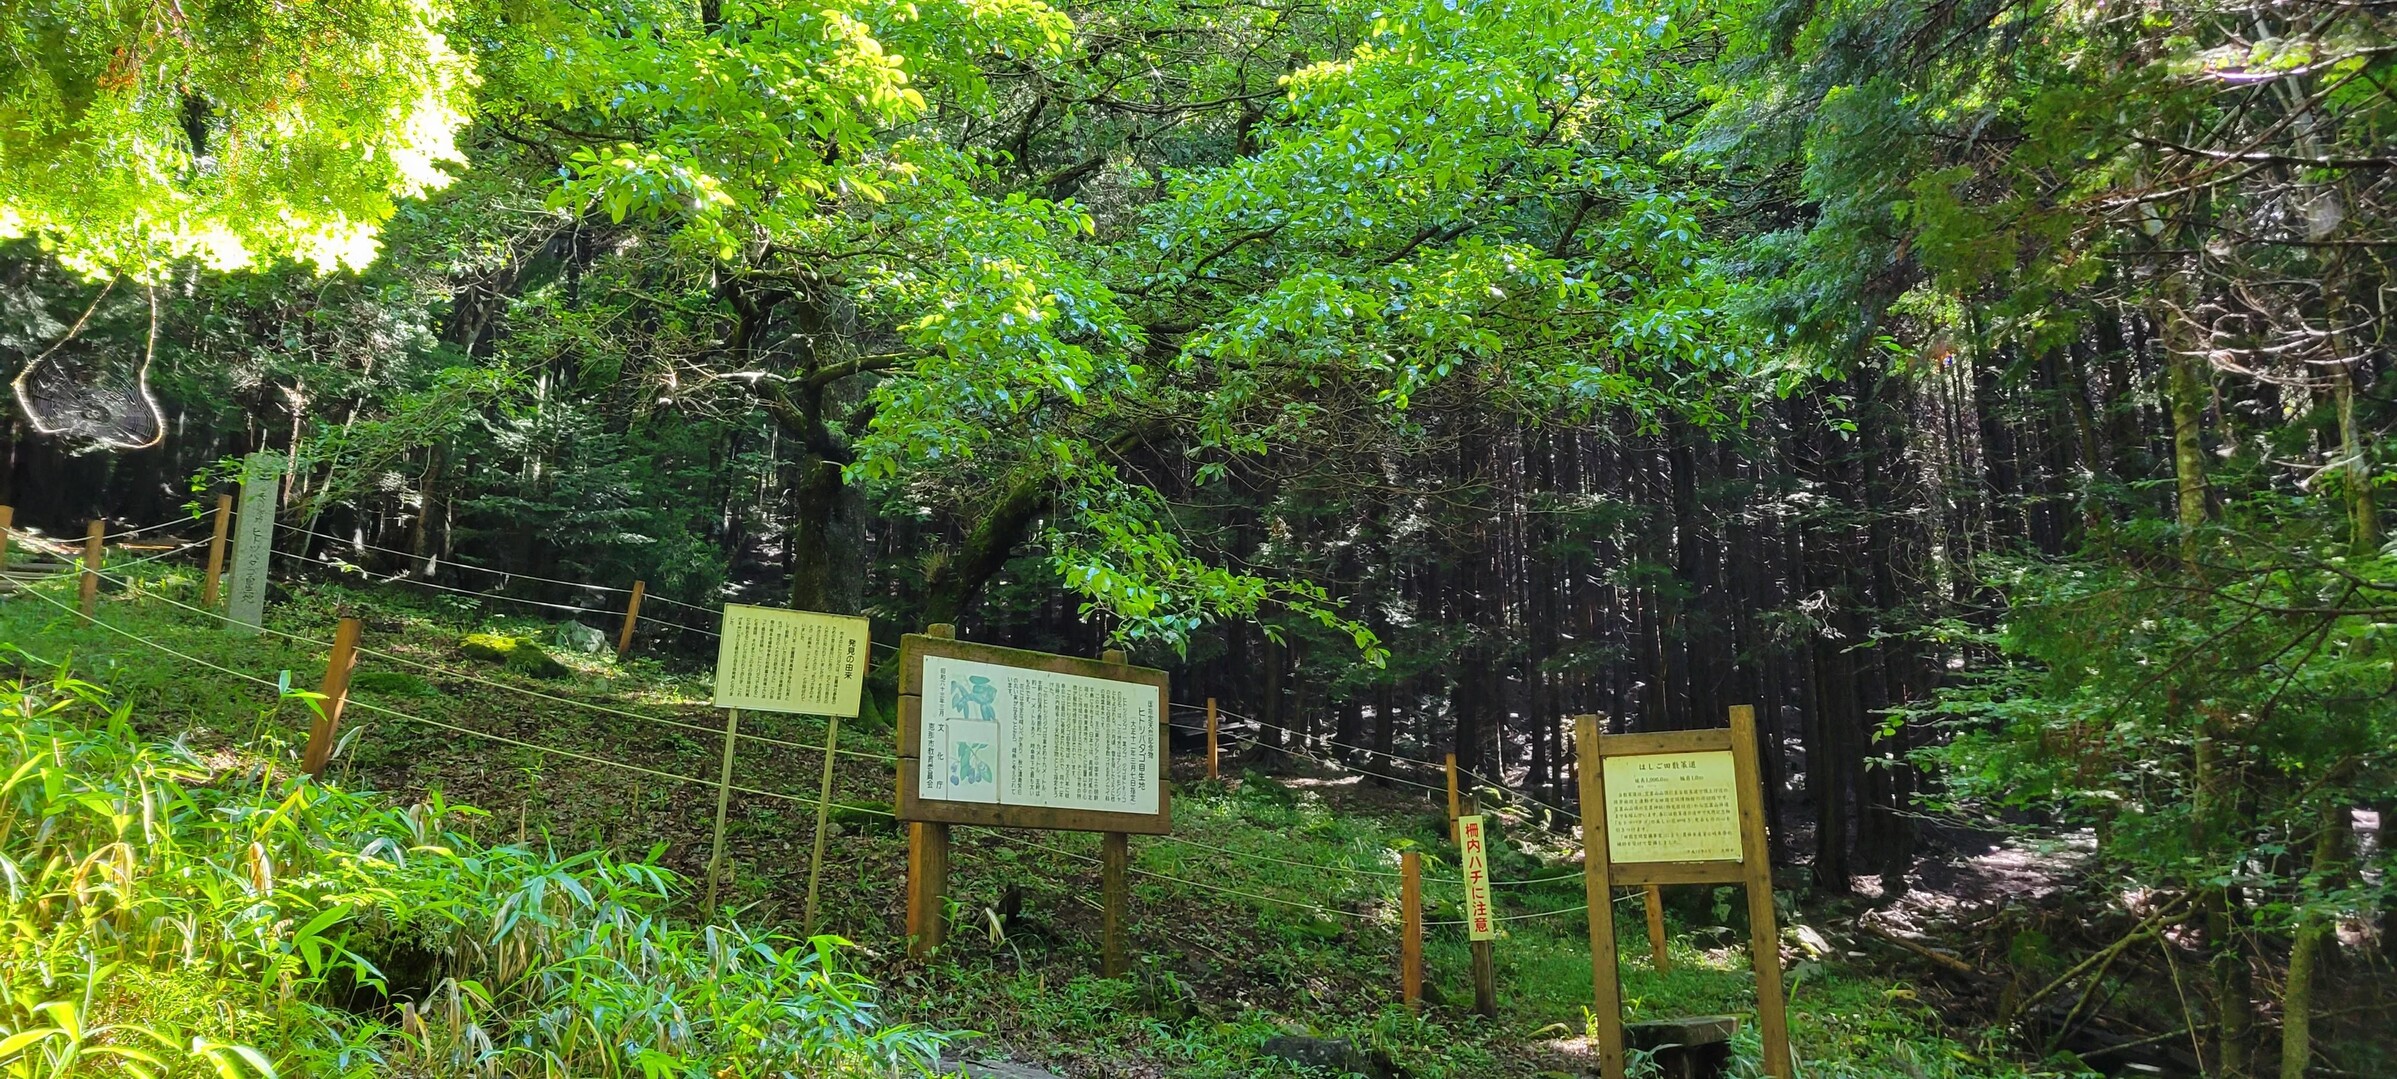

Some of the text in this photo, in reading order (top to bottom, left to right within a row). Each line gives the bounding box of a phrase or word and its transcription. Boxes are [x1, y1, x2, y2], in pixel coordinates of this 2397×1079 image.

[844, 638, 857, 679] 発見の由来
[935, 723, 945, 789] 文化庁
[1138, 707, 1146, 790] ヒトツバタゴ自生地
[1638, 760, 1696, 771] はしご田散策道
[1465, 823, 1489, 933] 柵内ハチに注意
